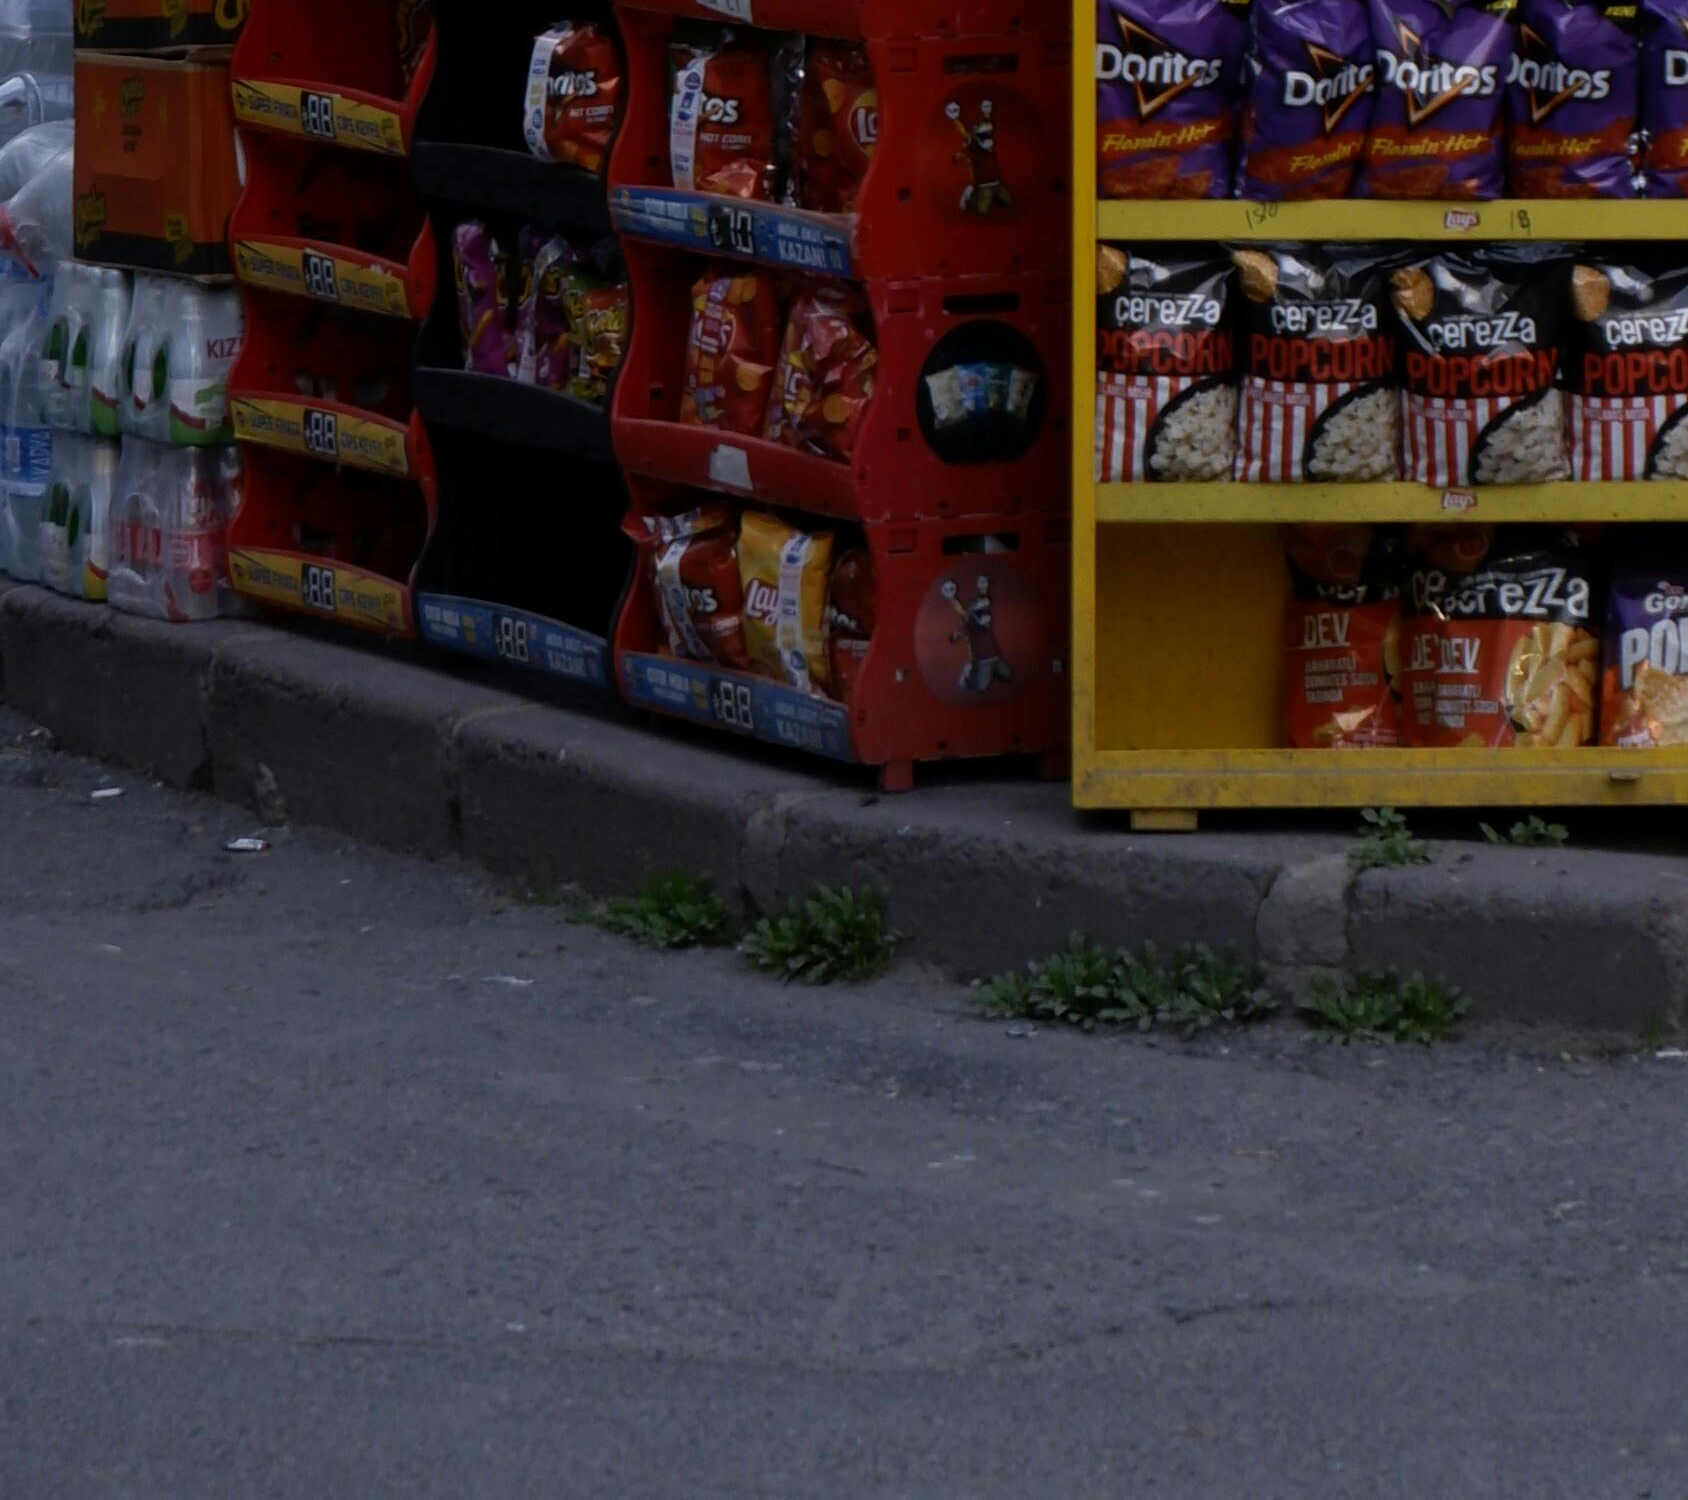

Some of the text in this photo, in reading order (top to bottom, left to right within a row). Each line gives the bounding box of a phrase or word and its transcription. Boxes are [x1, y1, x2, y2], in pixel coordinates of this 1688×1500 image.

[1097, 42, 1222, 87] Doritos
[1099, 330, 1234, 375] POPCORN
[1249, 337, 1394, 382] POPCORN
[1406, 348, 1558, 398] POPCORN
[1303, 611, 1351, 646] DEV
[1439, 637, 1480, 672] DEV
